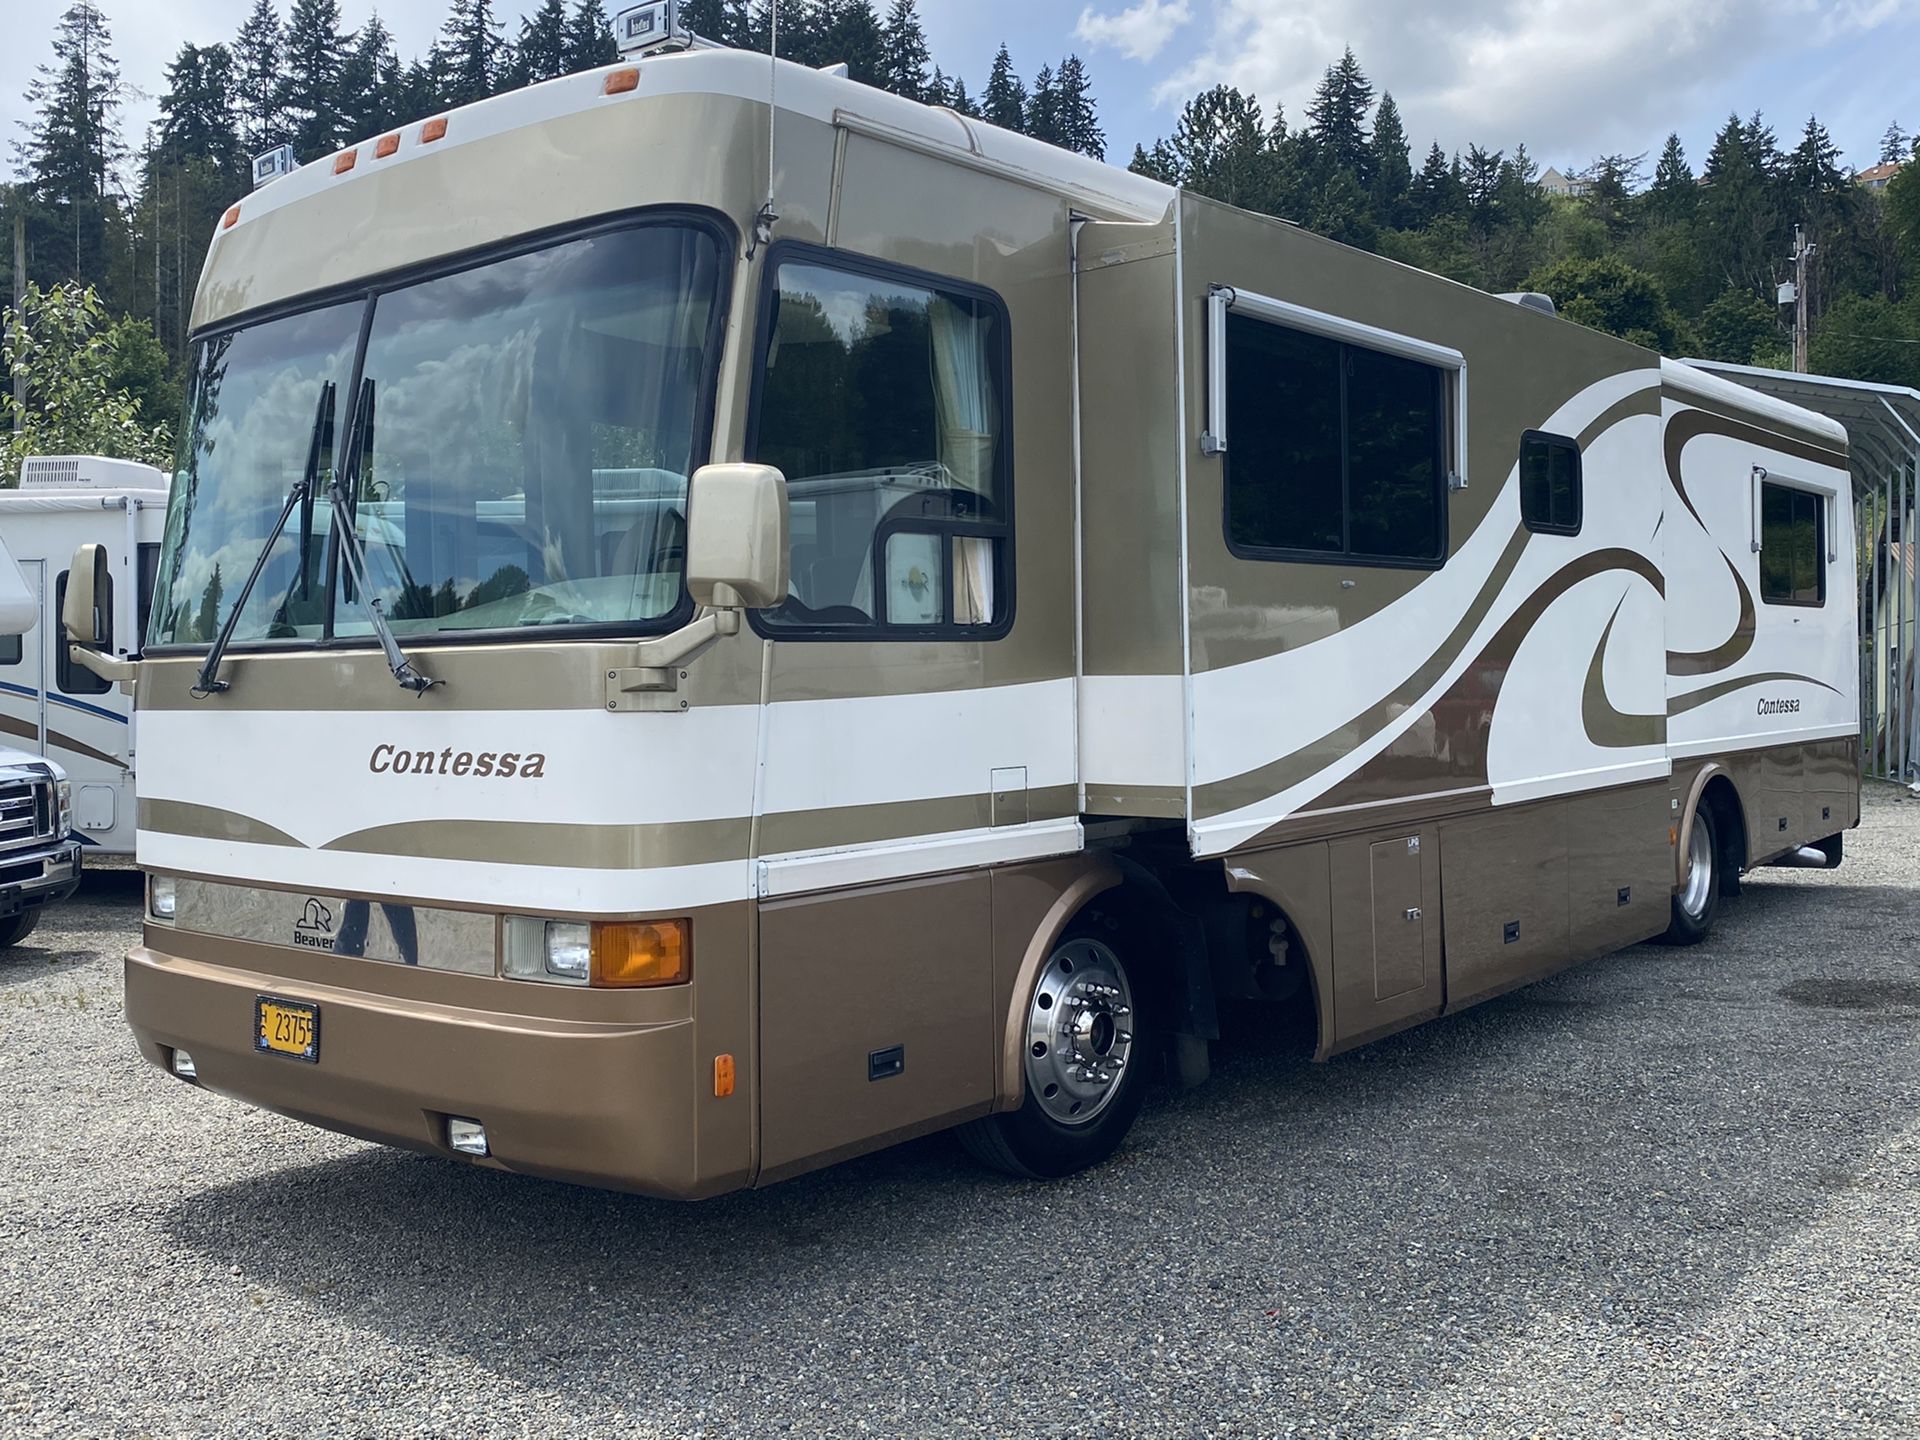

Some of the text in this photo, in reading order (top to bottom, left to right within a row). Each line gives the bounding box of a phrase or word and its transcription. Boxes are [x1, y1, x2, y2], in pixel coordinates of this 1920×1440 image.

[1757, 697, 1800, 715] Contessa
[369, 744, 546, 778] Contessa
[293, 931, 335, 949] Beaver
